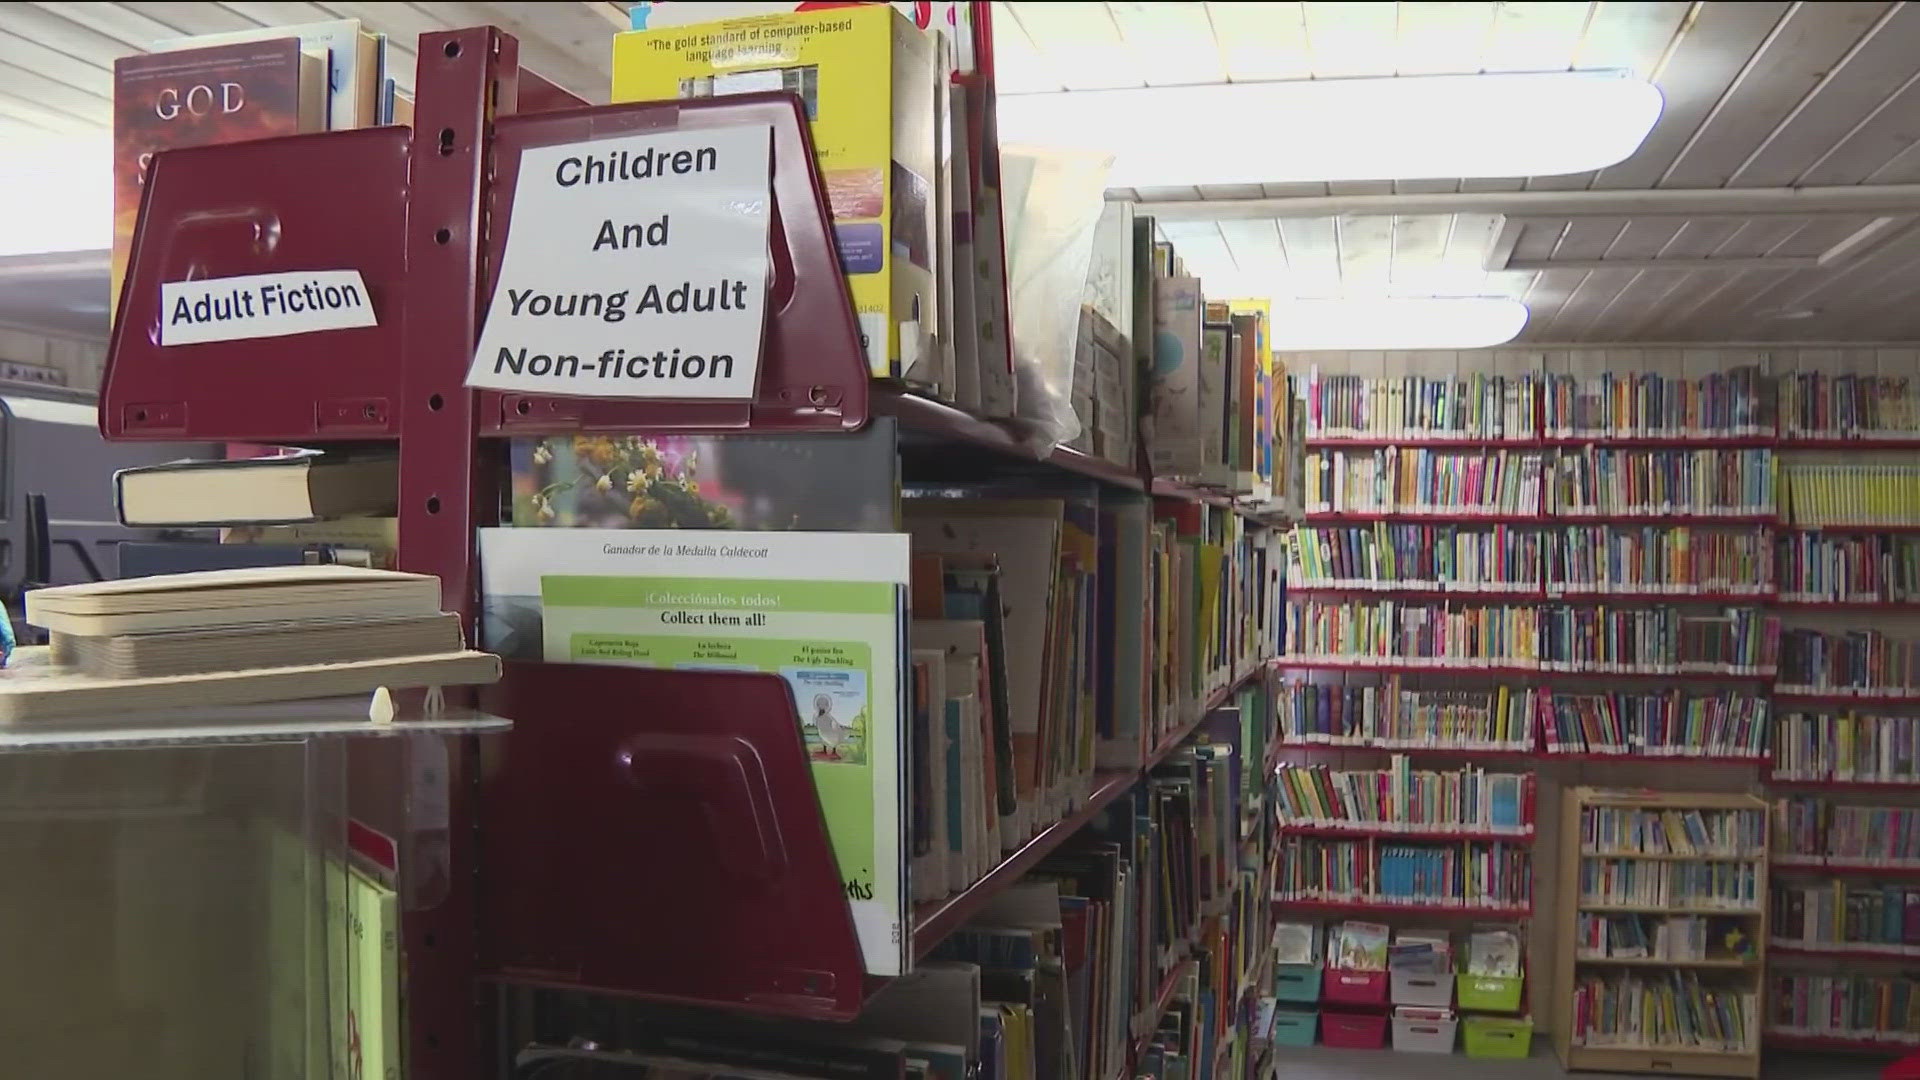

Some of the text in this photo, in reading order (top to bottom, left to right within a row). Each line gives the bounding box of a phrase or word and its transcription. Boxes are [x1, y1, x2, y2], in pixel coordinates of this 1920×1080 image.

[675, 34, 698, 52] gold
[700, 29, 747, 47] standard
[750, 27, 760, 40] of
[764, 19, 852, 40] computer-based
[686, 47, 734, 63] language
[737, 41, 782, 57] learning
[155, 82, 246, 121] GOD
[555, 146, 718, 188] Children
[592, 214, 670, 252] And
[171, 280, 362, 326] Adult Fiction
[507, 279, 748, 323] Young Adult
[493, 346, 735, 379] Non-fiction
[602, 543, 769, 559] Ganador de la Medalla Caldecott
[740, 593, 780, 607] todos!
[660, 610, 767, 627] Collect them all!
